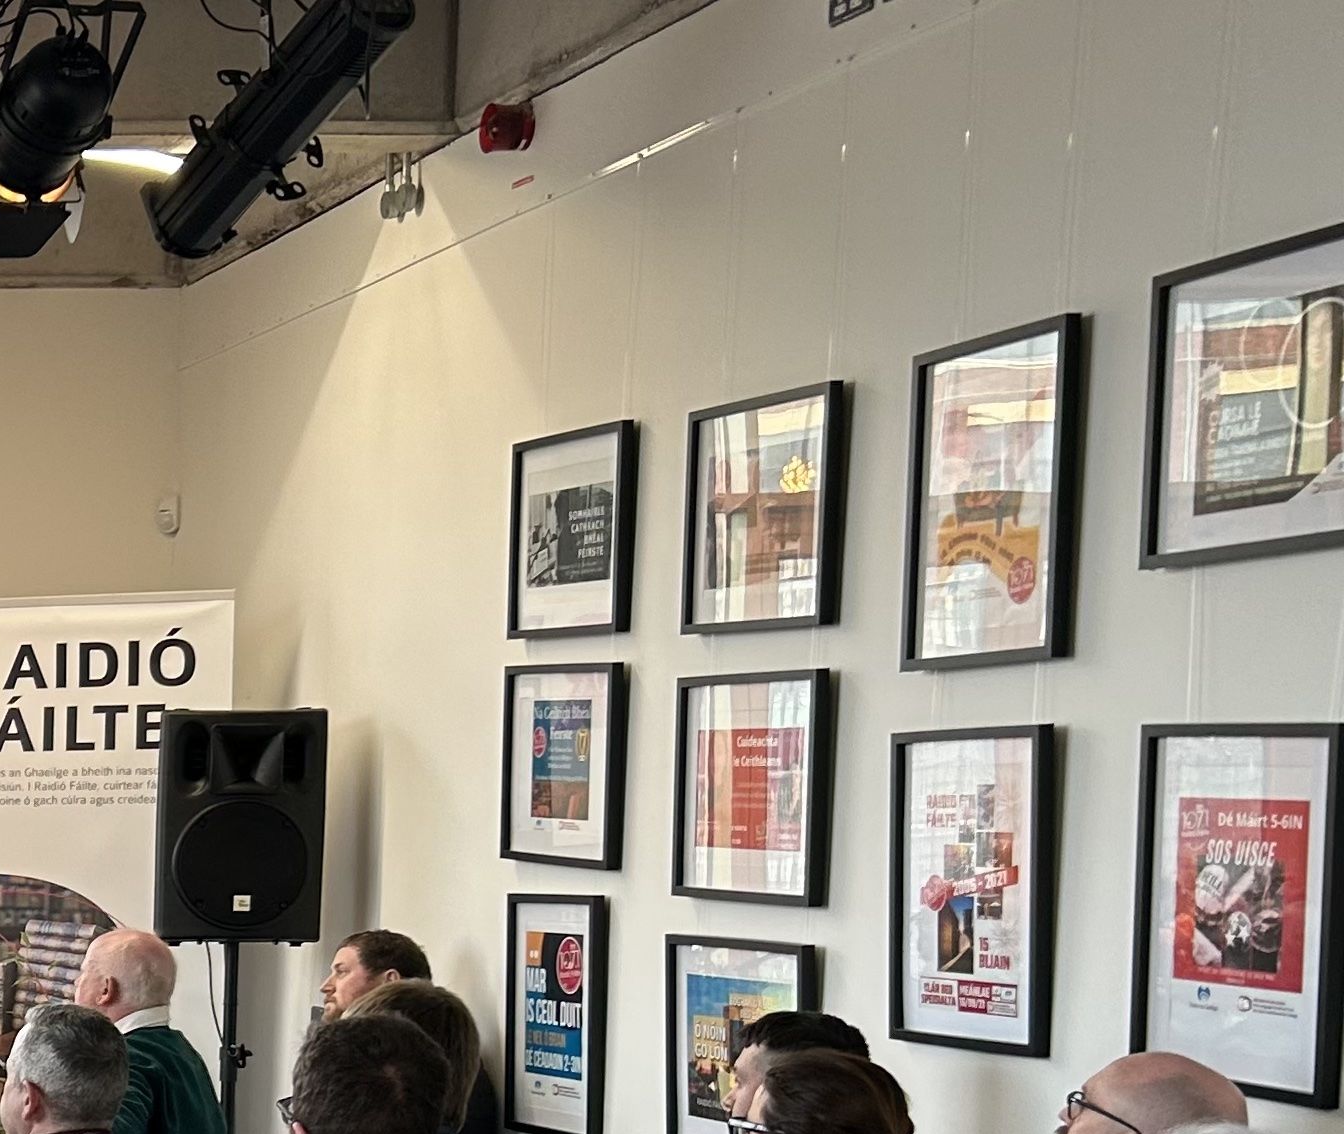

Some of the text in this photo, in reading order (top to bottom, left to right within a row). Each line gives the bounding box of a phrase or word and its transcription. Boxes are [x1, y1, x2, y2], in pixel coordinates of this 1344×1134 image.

[8, 769, 22, 778] an
[24, 766, 69, 780] Ghaeilge
[71, 769, 79, 777] a
[81, 766, 113, 777] bheith
[115, 767, 133, 777] ina
[33, 780, 67, 792] Raidió
[102, 780, 144, 791] cuirtear
[23, 795, 31, 806] ó
[33, 795, 58, 808] gach
[61, 795, 88, 806] cúlra
[89, 797, 115, 808] agus
[1217, 811, 1233, 827] Dé
[1205, 839, 1278, 868] SOS UISCE
[978, 936, 989, 952] 15
[526, 965, 547, 994] MAR
[535, 998, 559, 1026] CEOL
[559, 1001, 582, 1029] DUIT
[709, 1042, 728, 1061] LÓN
